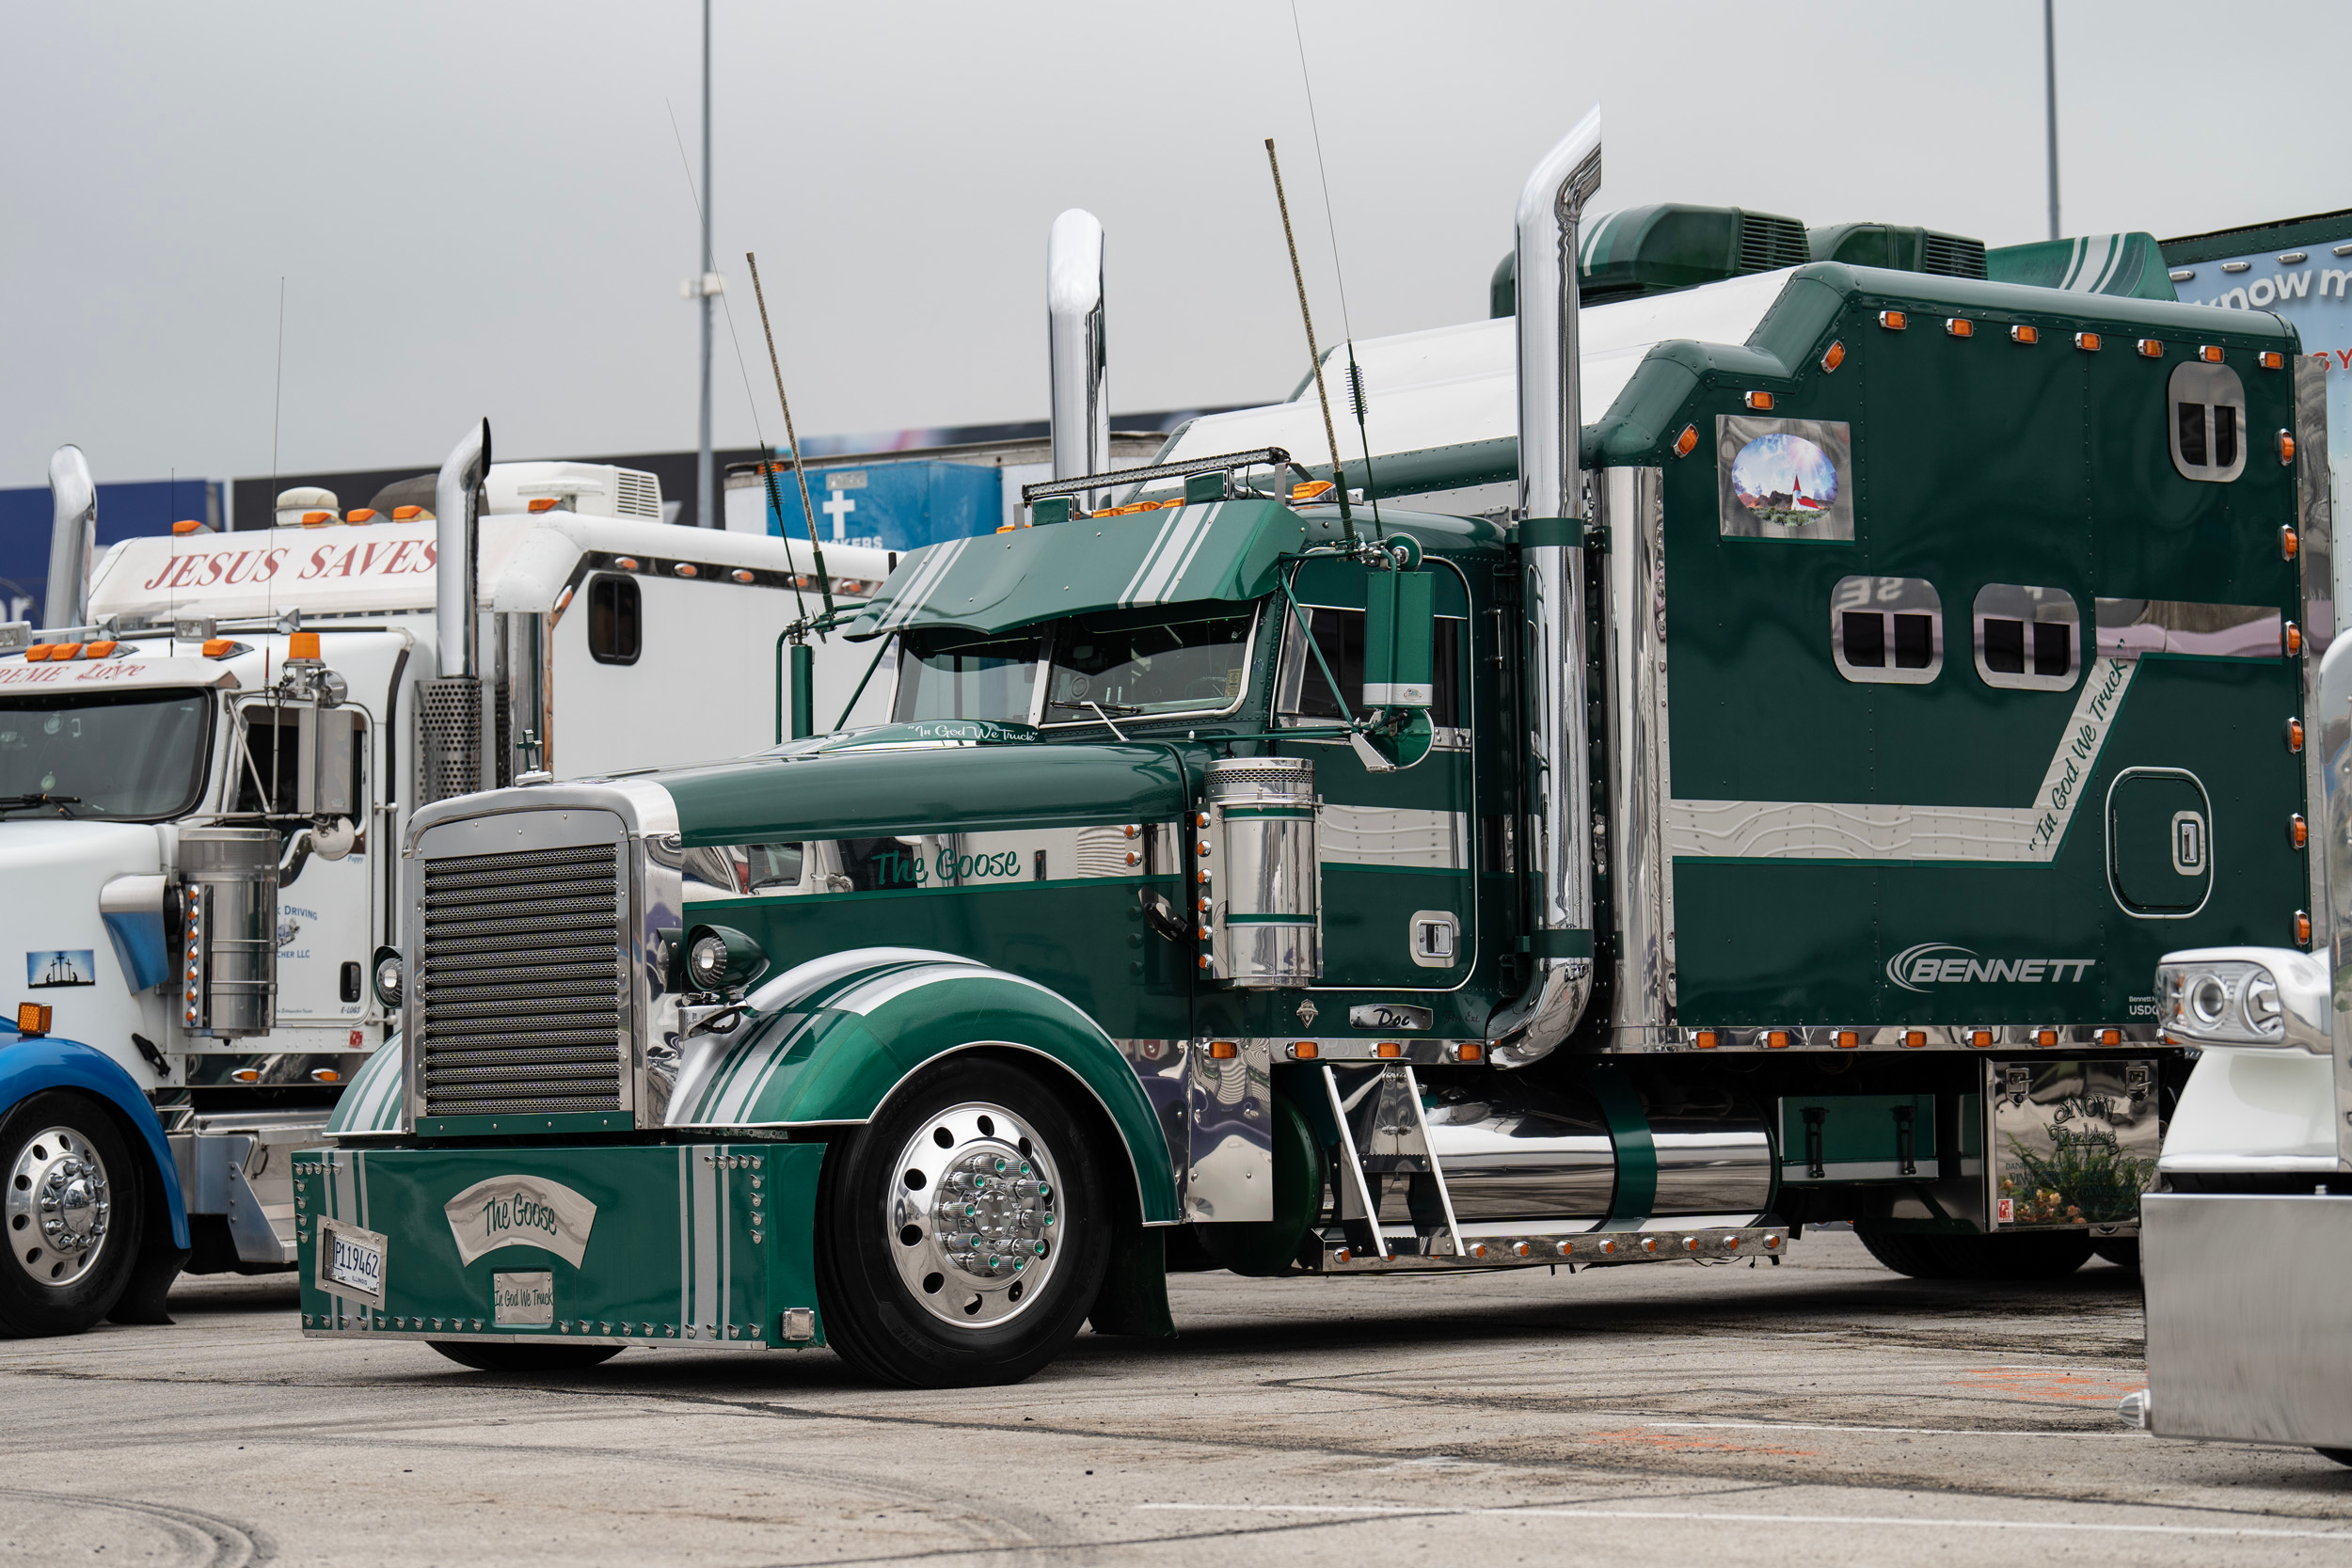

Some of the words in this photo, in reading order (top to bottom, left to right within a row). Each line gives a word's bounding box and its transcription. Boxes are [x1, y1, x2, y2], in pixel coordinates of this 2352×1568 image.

[2193, 270, 2312, 310] now
[144, 547, 291, 590] JESUS
[296, 539, 437, 580] SAVES
[74, 662, 147, 682] Love
[934, 725, 965, 738] God
[966, 725, 999, 739] We
[2051, 757, 2080, 811] God
[2071, 724, 2097, 760] We
[347, 854, 364, 864] Poppy
[871, 849, 929, 885] The
[935, 847, 1021, 880] Goose
[284, 905, 318, 921] DRIVING
[296, 949, 310, 958] LLC
[1908, 958, 2096, 983] BENNETT
[1373, 1007, 1410, 1026] Doc
[2054, 1092, 2116, 1125] SNOW
[483, 1196, 510, 1237] The
[513, 1193, 557, 1236] Goose
[335, 1241, 378, 1279] P119462
[351, 1275, 368, 1286] ILLINOIS
[494, 1290, 503, 1307] In
[504, 1289, 518, 1307] God
[520, 1289, 532, 1307] We
[532, 1288, 554, 1307] Truck
